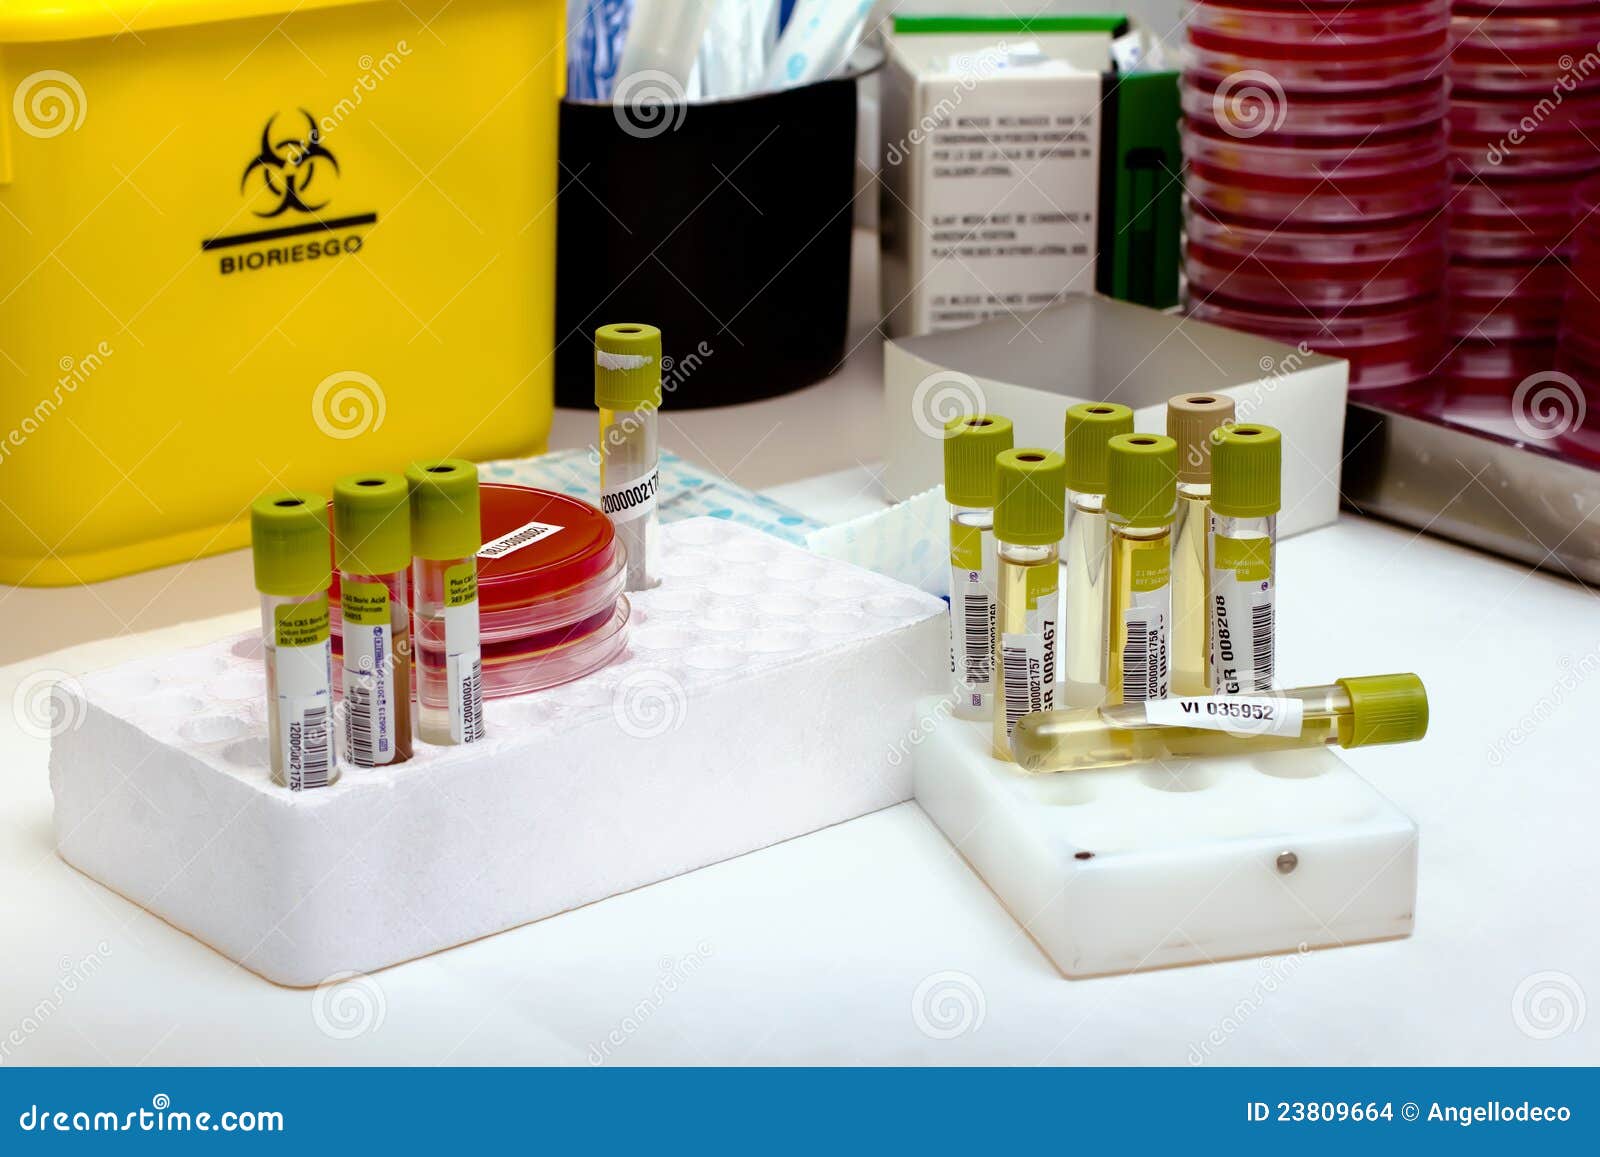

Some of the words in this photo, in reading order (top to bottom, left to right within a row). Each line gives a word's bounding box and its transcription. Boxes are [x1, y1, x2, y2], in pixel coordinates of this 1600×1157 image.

[219, 235, 364, 276] BIORIESGO
[371, 596, 386, 604] Acid
[1215, 595, 1235, 662] 008208
[1043, 620, 1056, 685] 008467
[1223, 668, 1241, 694] GR
[1180, 701, 1200, 714] VI
[1206, 702, 1275, 721] 035952
